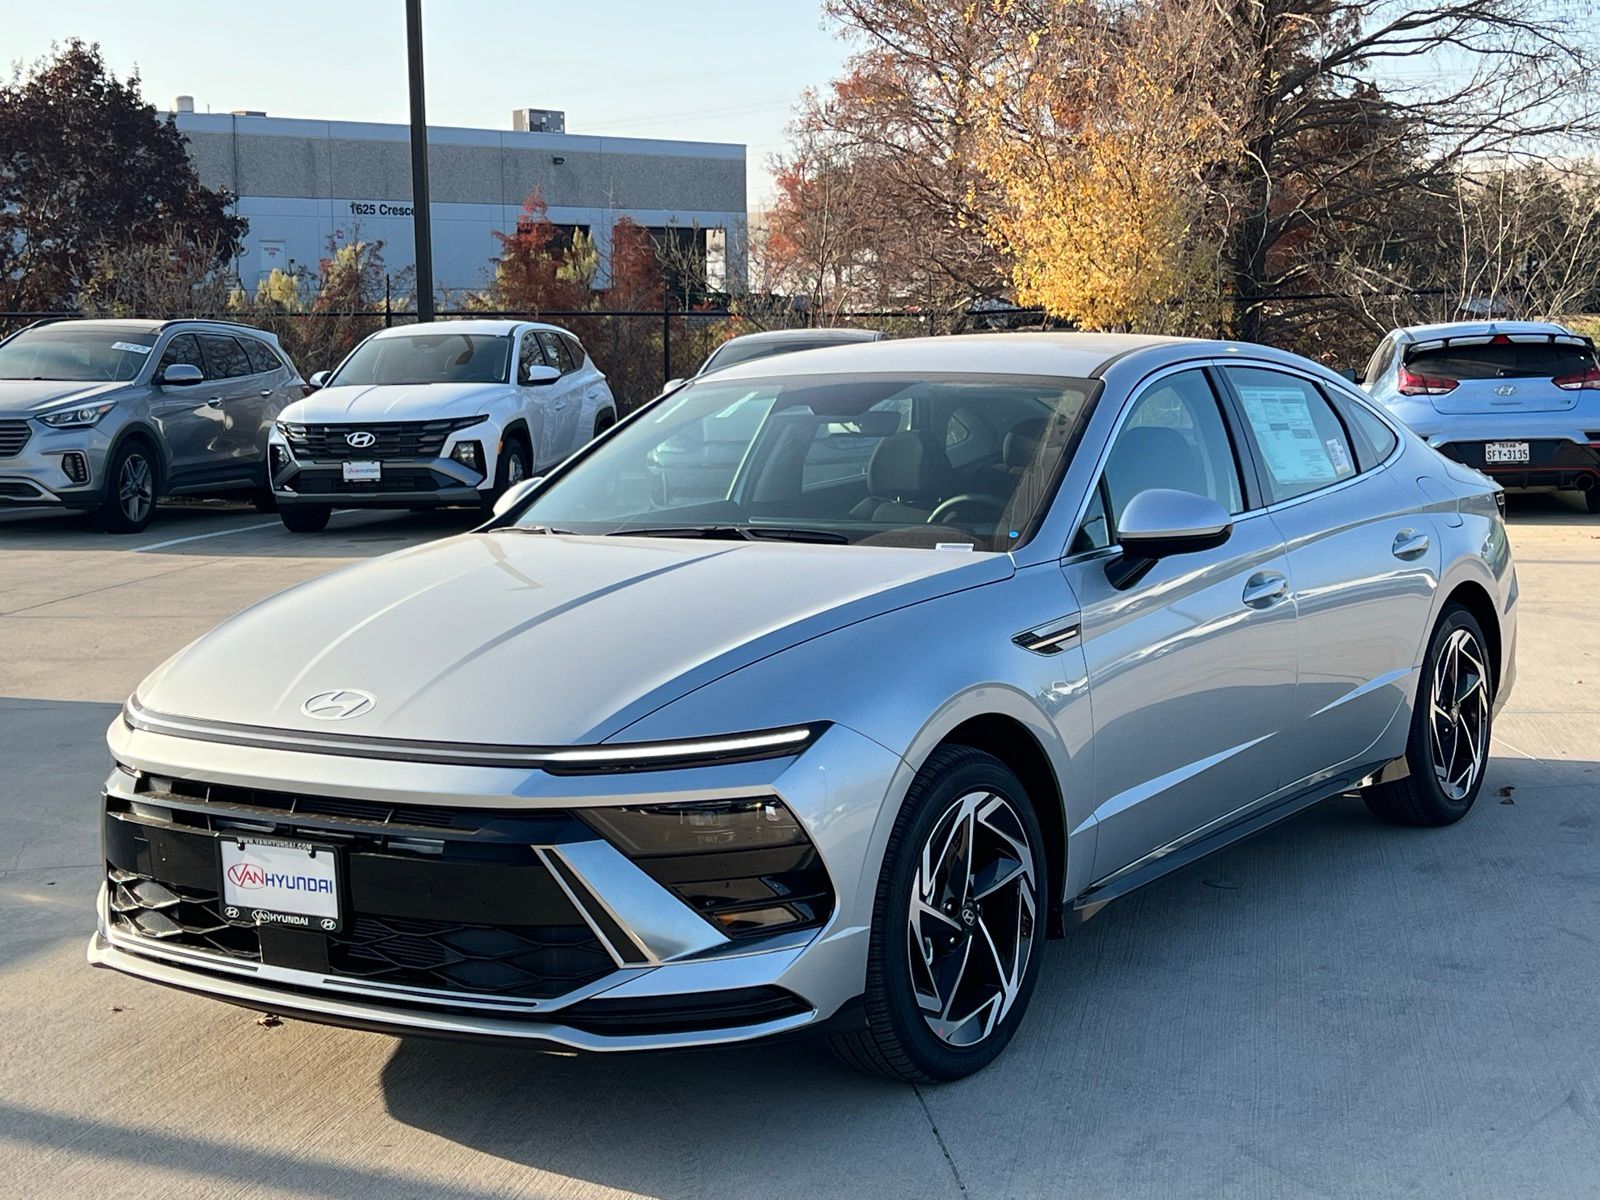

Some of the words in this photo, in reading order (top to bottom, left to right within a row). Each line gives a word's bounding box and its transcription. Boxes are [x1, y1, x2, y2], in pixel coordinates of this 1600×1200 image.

[350, 203, 376, 215] 1625
[265, 873, 333, 894] HYUNDAI
[270, 913, 309, 926] HYUNDAI
